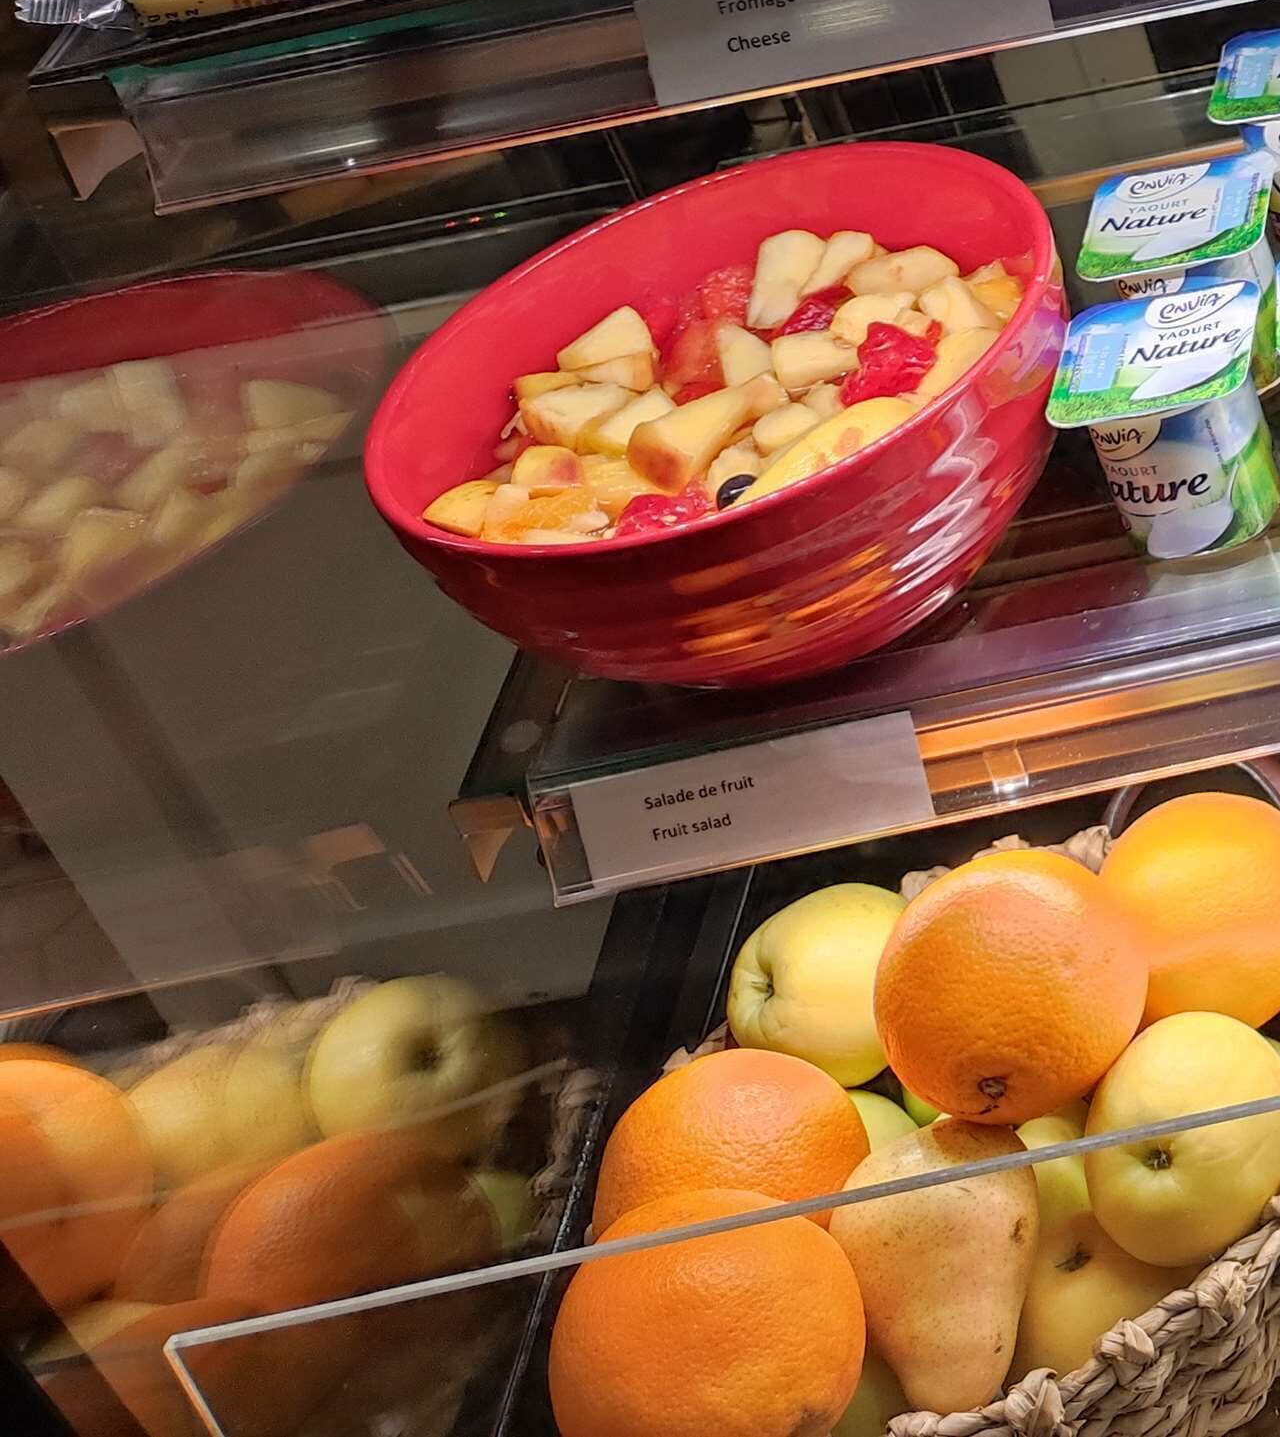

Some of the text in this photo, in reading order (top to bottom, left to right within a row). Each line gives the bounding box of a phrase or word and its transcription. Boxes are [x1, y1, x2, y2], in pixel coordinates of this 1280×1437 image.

[727, 29, 792, 53] Cheese
[1128, 198, 1190, 214] YAOURT
[1100, 207, 1208, 232] Nature
[1157, 321, 1221, 341] YAOURT
[1129, 328, 1242, 364] Nature
[1111, 472, 1210, 504] ature
[644, 776, 755, 810] Salade de fruit
[652, 813, 732, 841] Fruit salad
